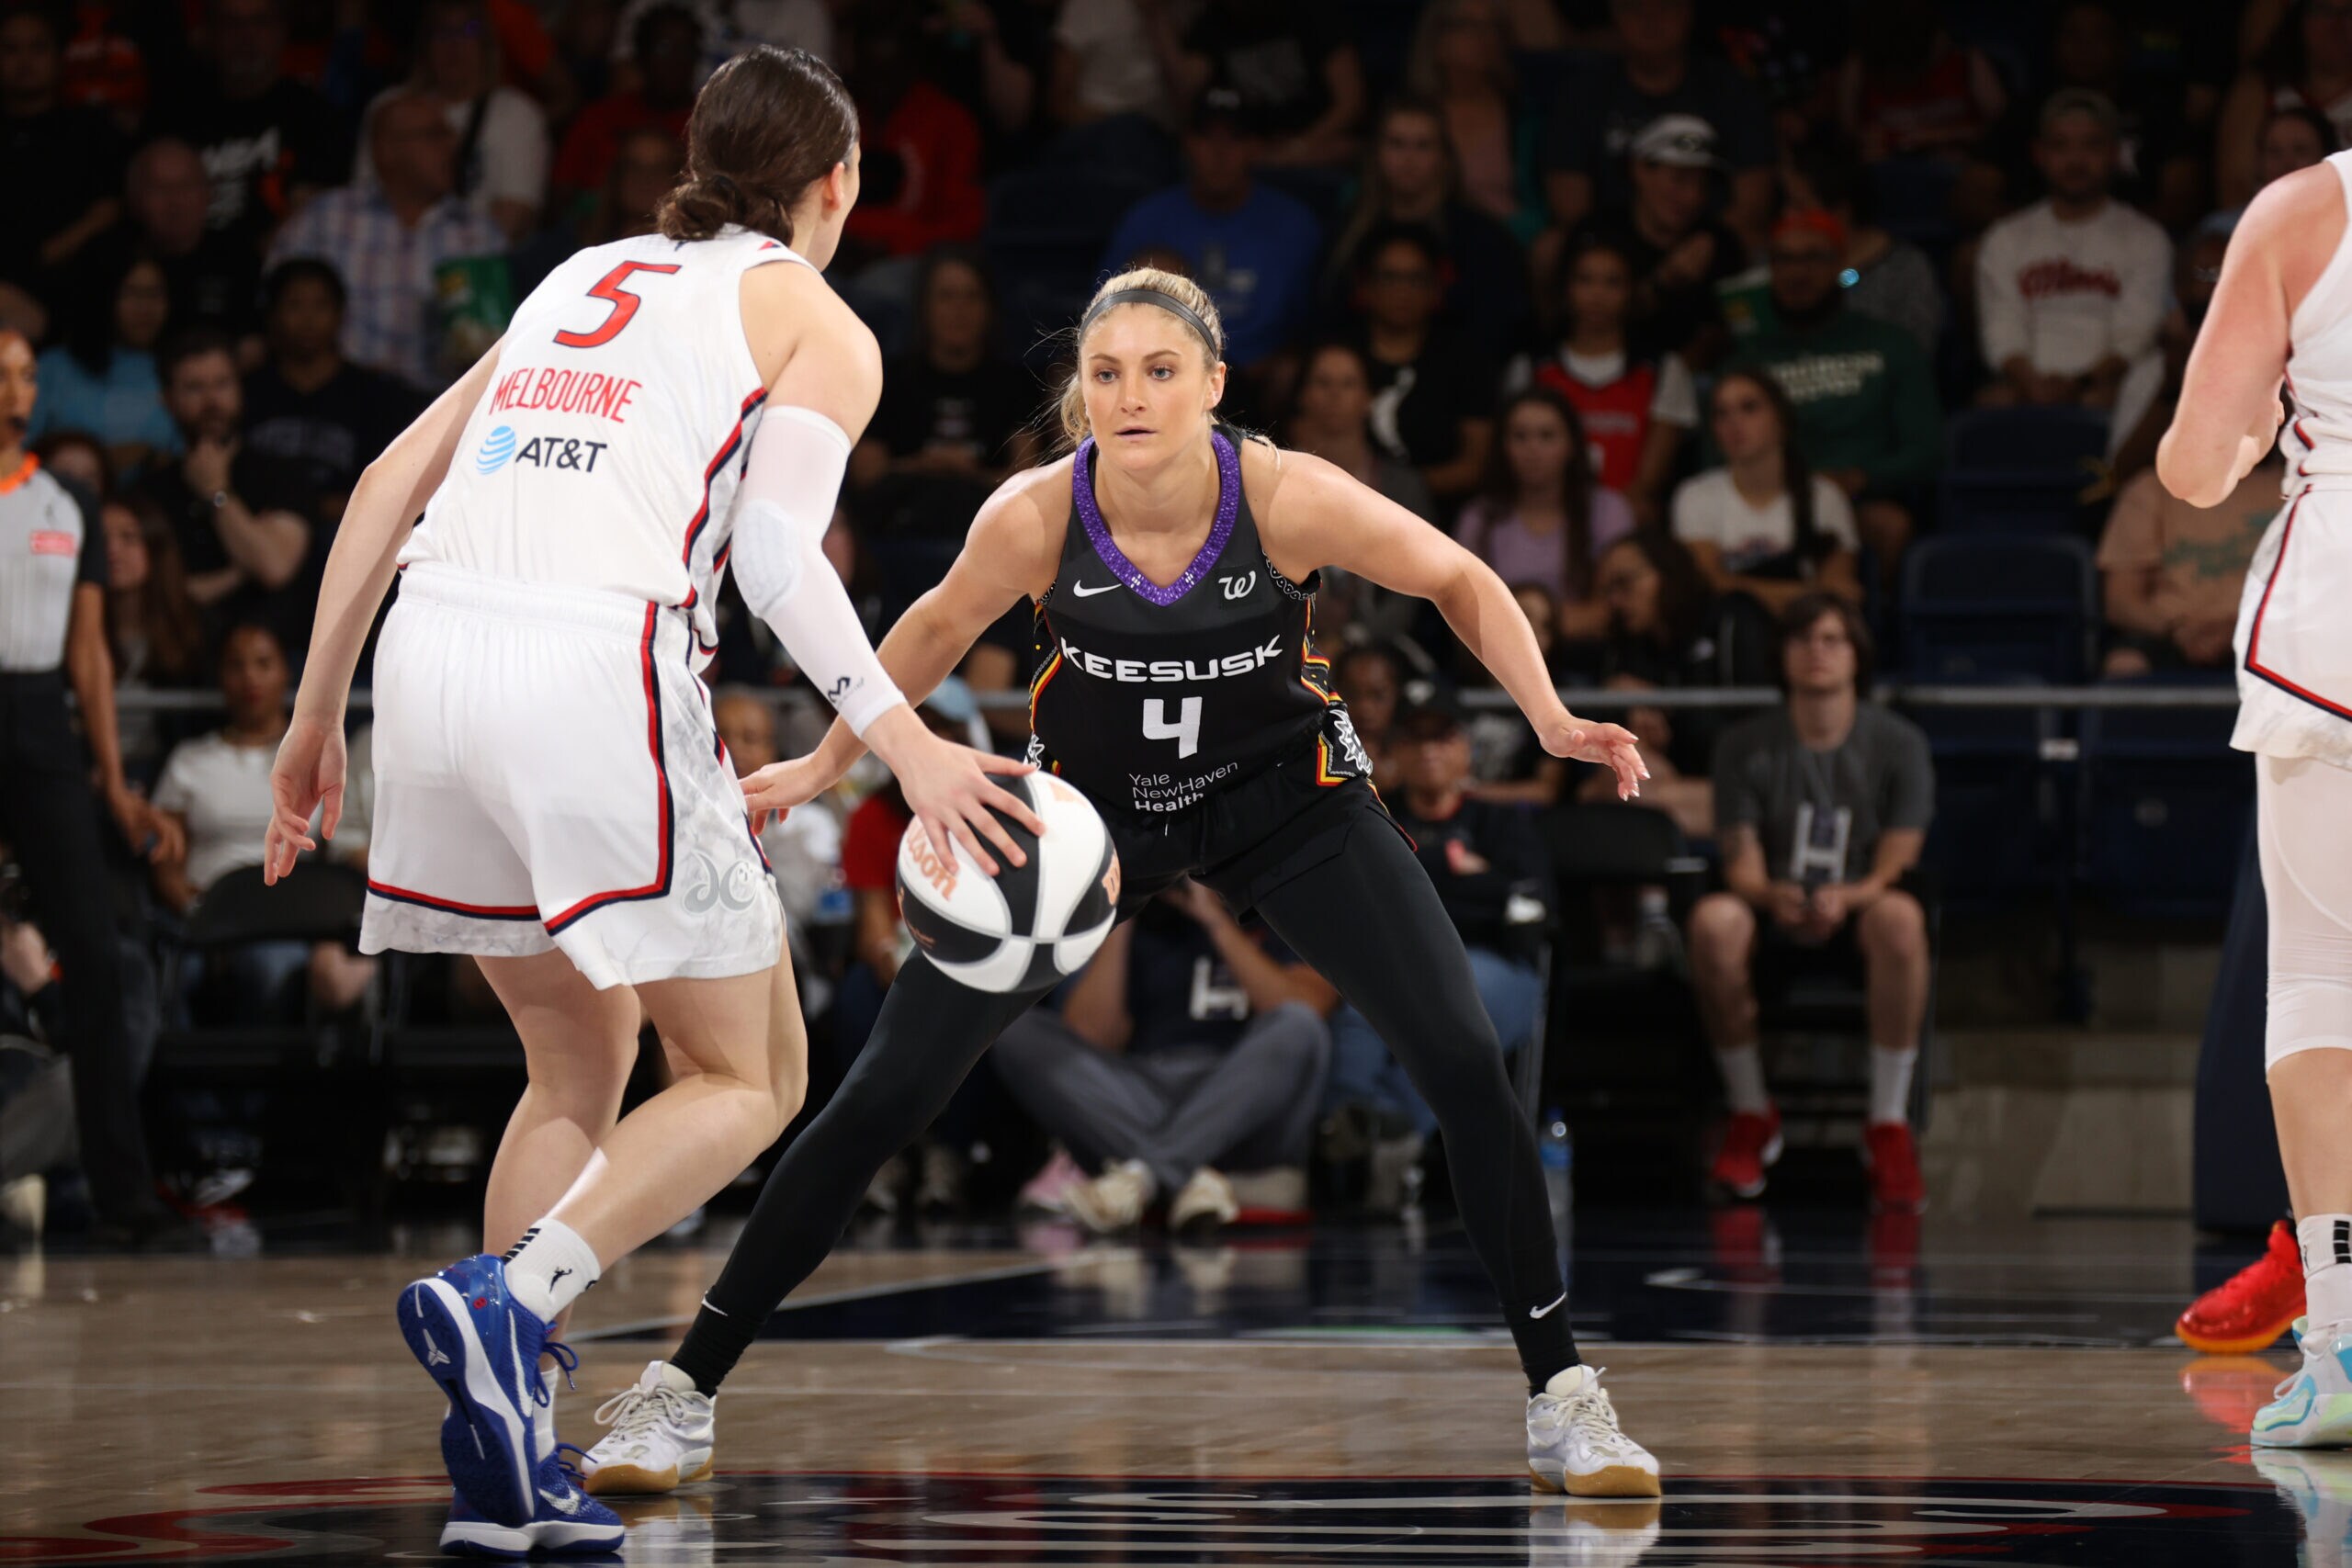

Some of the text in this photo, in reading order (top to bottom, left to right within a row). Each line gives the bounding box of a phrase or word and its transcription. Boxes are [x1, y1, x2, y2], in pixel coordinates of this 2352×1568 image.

[553, 260, 682, 348] 5
[489, 367, 642, 423] MELBOURNE
[515, 437, 607, 473] AT&T
[1060, 634, 1283, 682] KEESUSK
[1142, 696, 1203, 760] 4
[1128, 773, 1170, 786] Yale
[1135, 792, 1204, 812] Health
